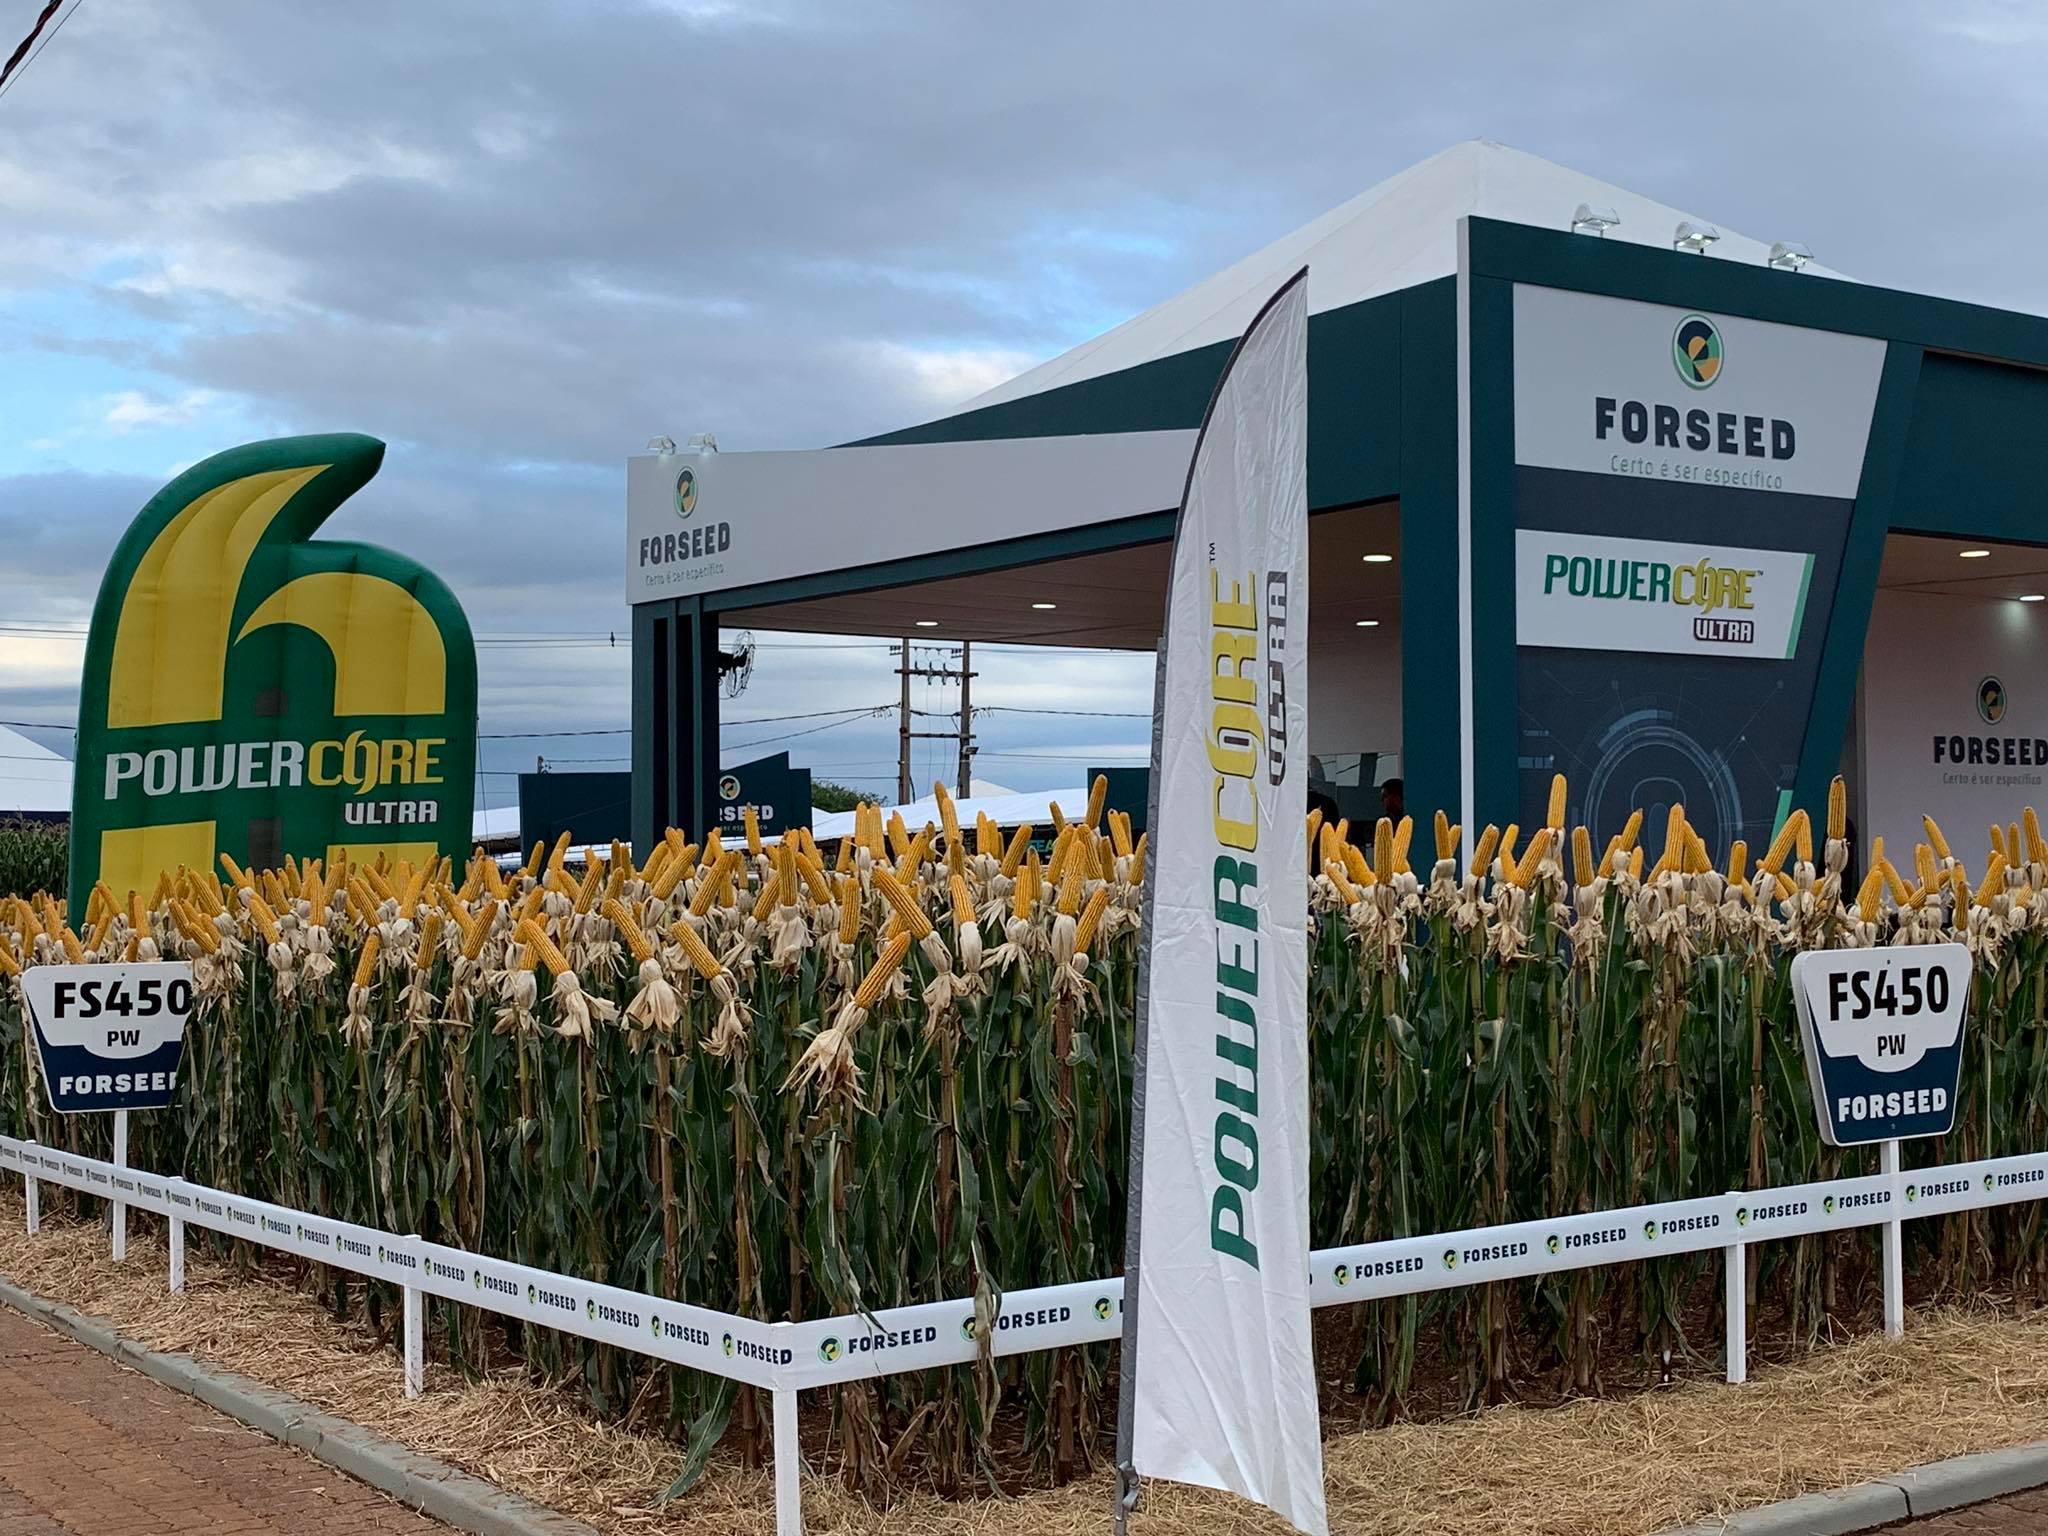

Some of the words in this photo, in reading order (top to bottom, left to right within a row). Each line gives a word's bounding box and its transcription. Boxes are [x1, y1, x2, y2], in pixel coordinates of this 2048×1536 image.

[1595, 397, 1796, 460] FORSEED
[1611, 455, 1653, 475] Certo
[1661, 459, 1668, 477] é
[1675, 464, 1698, 480] ser
[1705, 468, 1782, 489] específico
[640, 522, 730, 567] FORSEED
[1544, 554, 1755, 614] POWERCORE
[1694, 618, 1753, 642] ULTRA
[1267, 570, 1288, 786] ULTRA
[104, 729, 447, 800] POWERCORE
[1934, 736, 2048, 765] FORSEED
[345, 800, 438, 825] ULTRA
[1205, 567, 1266, 1272] POWERCORE
[54, 979, 193, 1018] FS450
[1829, 966, 1949, 1021] FS450
[107, 1030, 140, 1047] PW
[1877, 1034, 1906, 1056] PW
[1838, 1087, 1947, 1122] FORSEED
[848, 1327, 937, 1354] FORSEED
[999, 1306, 1071, 1331] ORSEED
[1355, 1257, 1423, 1280] FORSEED
[1464, 1242, 1528, 1264] FORSEED
[1566, 1228, 1626, 1248] FORSEED
[1662, 1215, 1720, 1234] FORSEED
[1753, 1202, 1808, 1221] FORSEED
[1839, 1191, 1891, 1209] FORSEED
[1921, 1180, 1970, 1197] FORSEED
[1998, 1170, 2044, 1187] FORSEED
[267, 1219, 291, 1235] FORSEED
[304, 1229, 329, 1245] FORSEED
[344, 1239, 371, 1256] FORSEED
[386, 1250, 416, 1268] FORSEED
[433, 1262, 465, 1282] FORSEED
[484, 1275, 518, 1296] FORSEED
[539, 1289, 576, 1311] FORSEED
[598, 1305, 639, 1328] FORSEED
[664, 1321, 709, 1346] FORSEED
[737, 1340, 792, 1365] FORSEED
